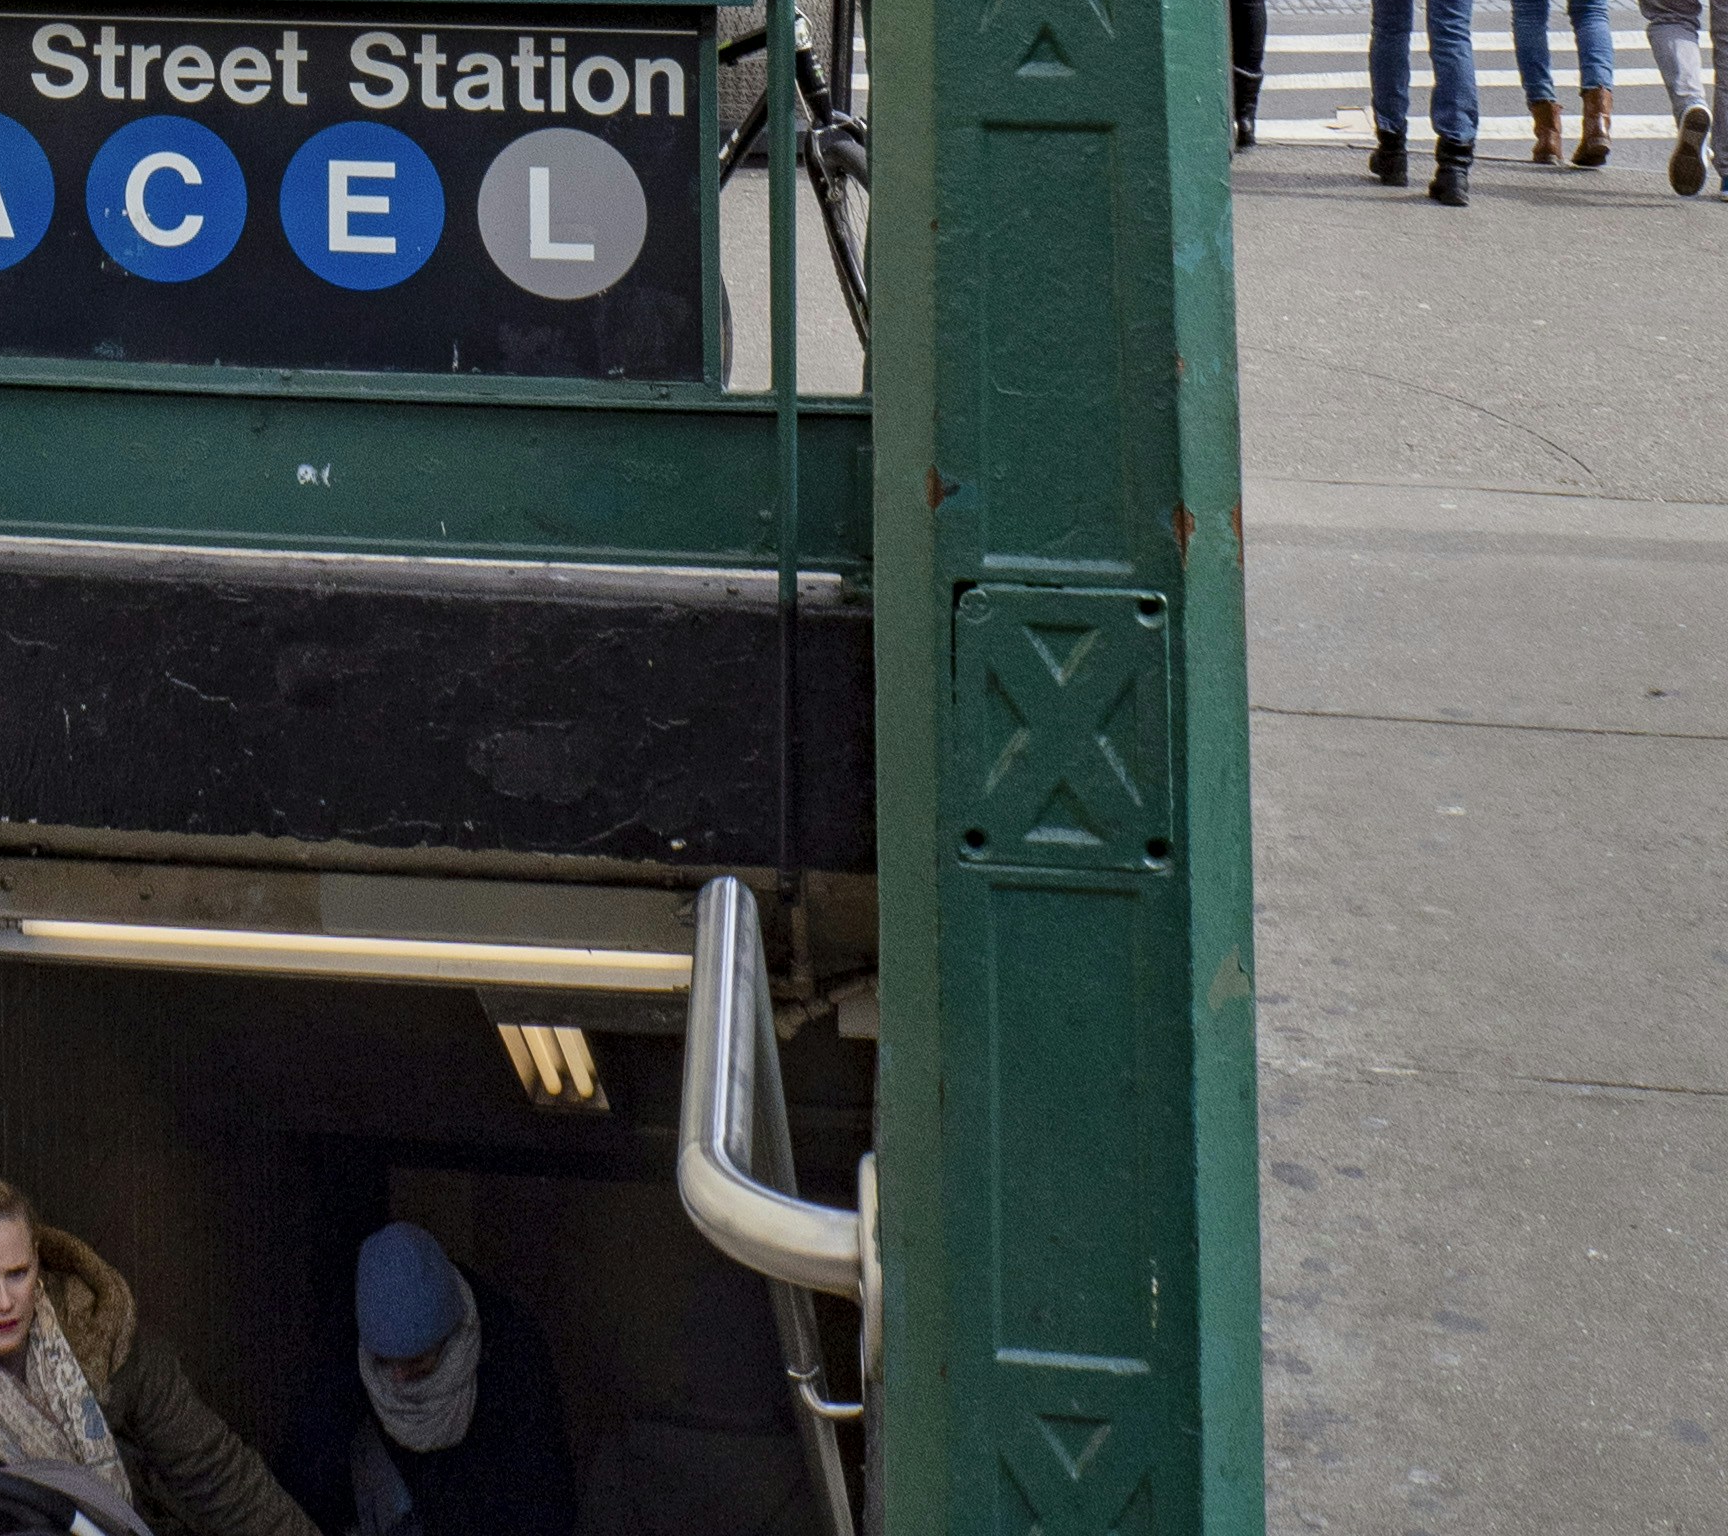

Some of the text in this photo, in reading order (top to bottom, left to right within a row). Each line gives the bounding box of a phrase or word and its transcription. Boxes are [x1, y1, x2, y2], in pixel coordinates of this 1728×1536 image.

[31, 23, 309, 105] Street
[350, 32, 685, 116] Station
[125, 151, 204, 247] C
[327, 161, 397, 254] E
[529, 166, 595, 261] L
